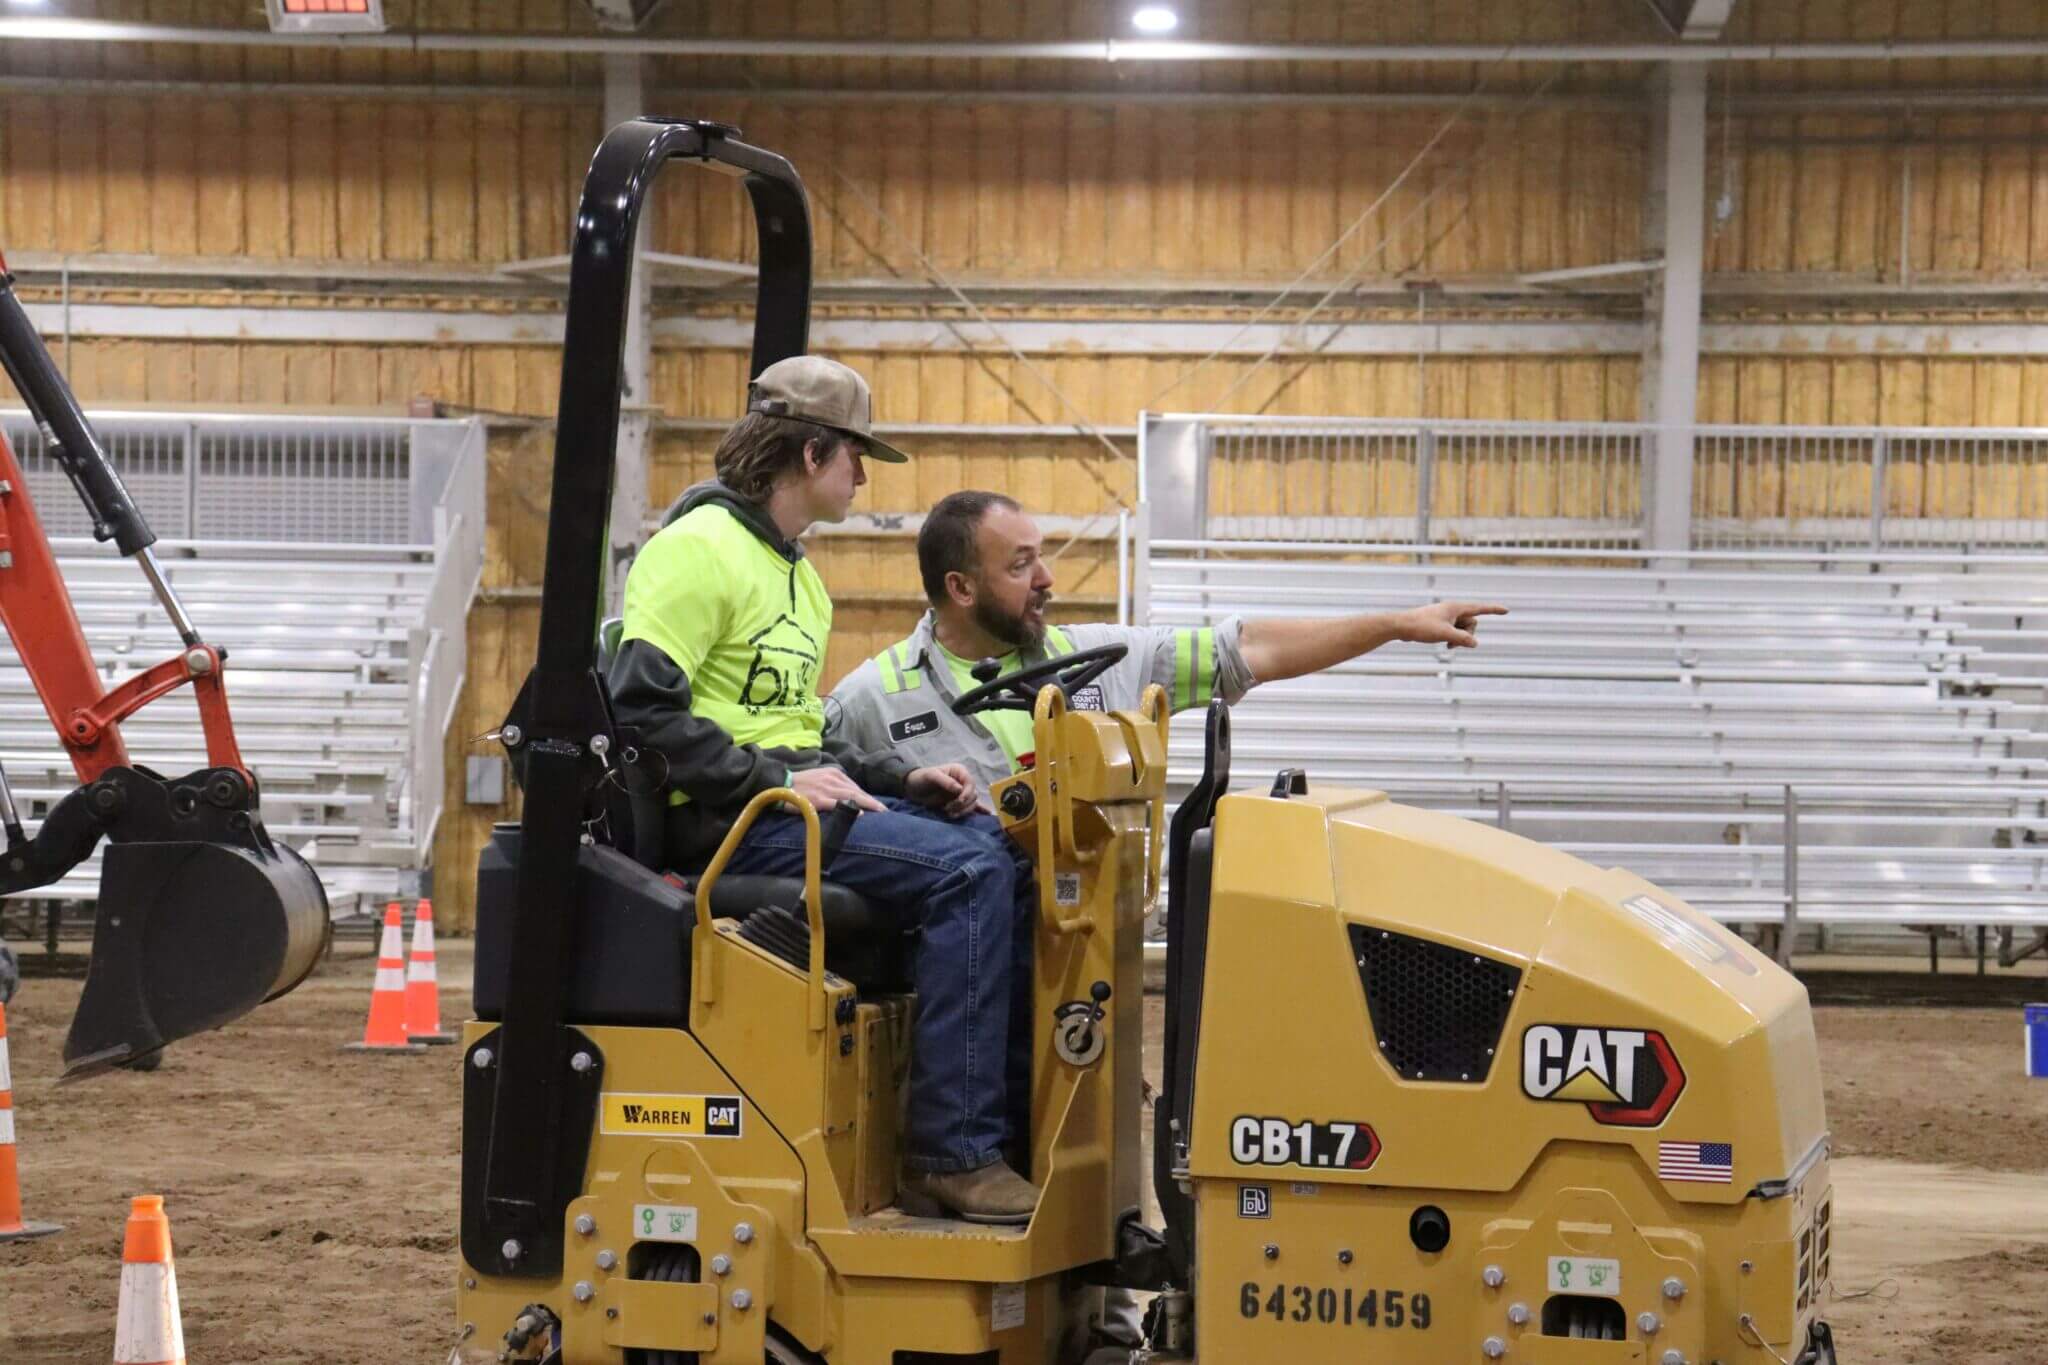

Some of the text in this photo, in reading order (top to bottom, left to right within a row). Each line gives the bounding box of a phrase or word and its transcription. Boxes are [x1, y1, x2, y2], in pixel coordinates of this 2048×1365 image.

[1071, 695, 1100, 703] COUNTY
[1523, 1025, 1646, 1102] CAT
[623, 1104, 738, 1126] WARREN CAT
[1231, 1117, 1358, 1168] CB1.7
[1240, 1281, 1432, 1330] 64301459
